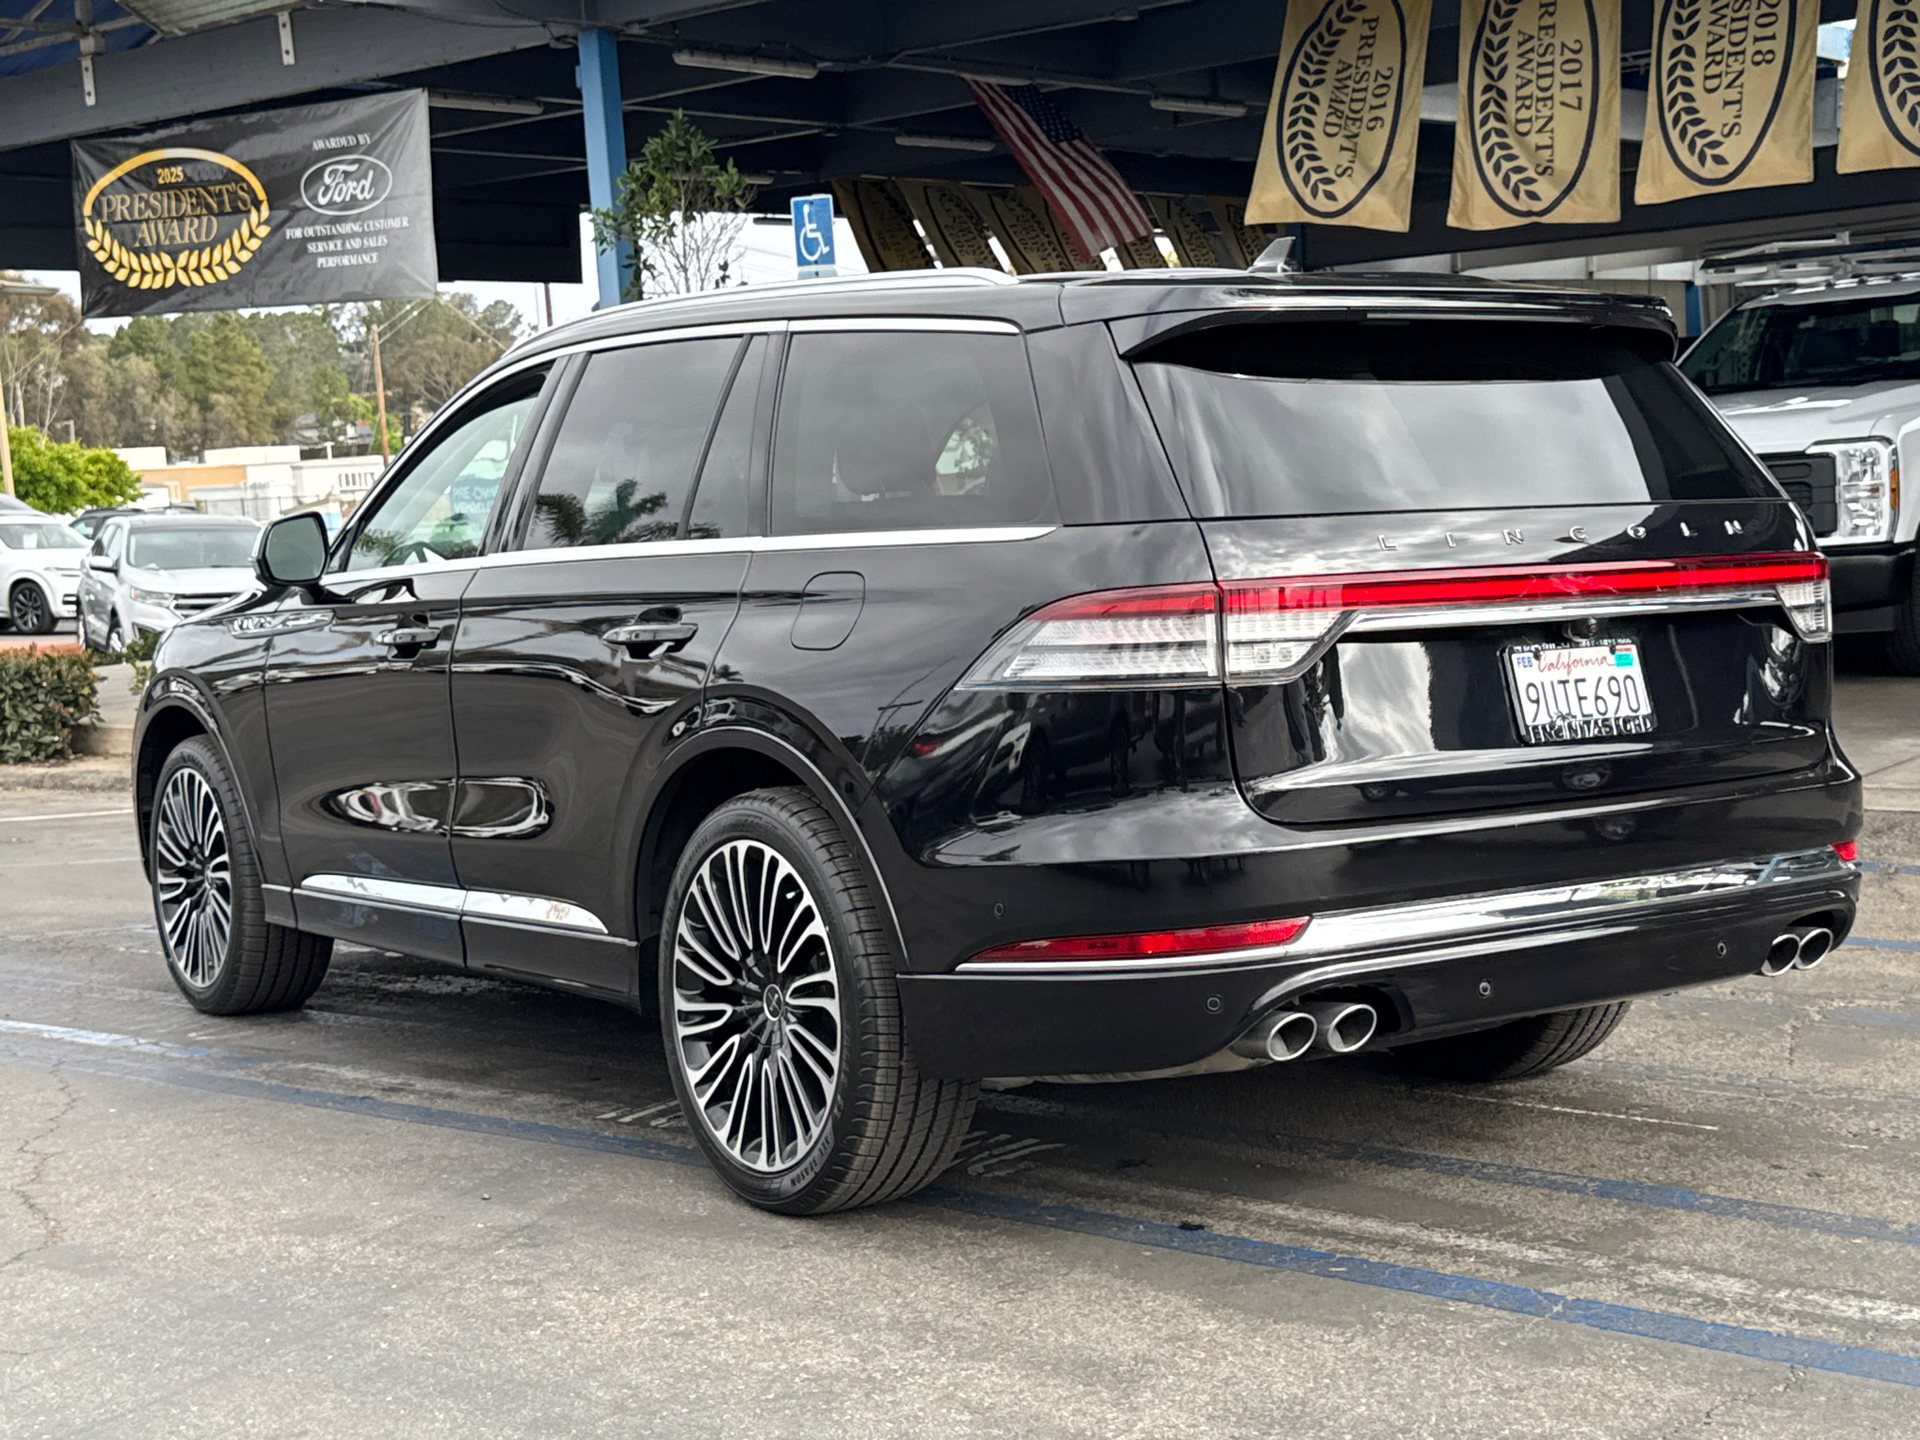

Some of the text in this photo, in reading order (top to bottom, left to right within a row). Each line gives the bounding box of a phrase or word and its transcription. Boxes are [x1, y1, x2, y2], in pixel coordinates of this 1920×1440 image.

[1702, 0, 1730, 94] WARD
[1513, 29, 1535, 137] AWARD
[1559, 39, 1584, 111] 2017
[1322, 58, 1354, 138] AWARD
[1334, 15, 1380, 178] PRESIDENT'S
[1365, 66, 1394, 132] 2016
[312, 132, 372, 151] AWARDED BY
[156, 166, 185, 185] 2025
[317, 163, 376, 206] Ford
[100, 182, 252, 223] PRESIDENT'S
[134, 215, 219, 248] AWARD
[285, 216, 410, 240] FOR OUTSTANDING CUSTOMER
[307, 234, 389, 253] SERVICE AND SALES
[317, 252, 379, 268] PERFORMANCE
[1377, 519, 1744, 551] LINCOLN
[1516, 656, 1534, 668] FEB
[1537, 651, 1616, 677] California
[1525, 674, 1641, 723] 9UTE690
